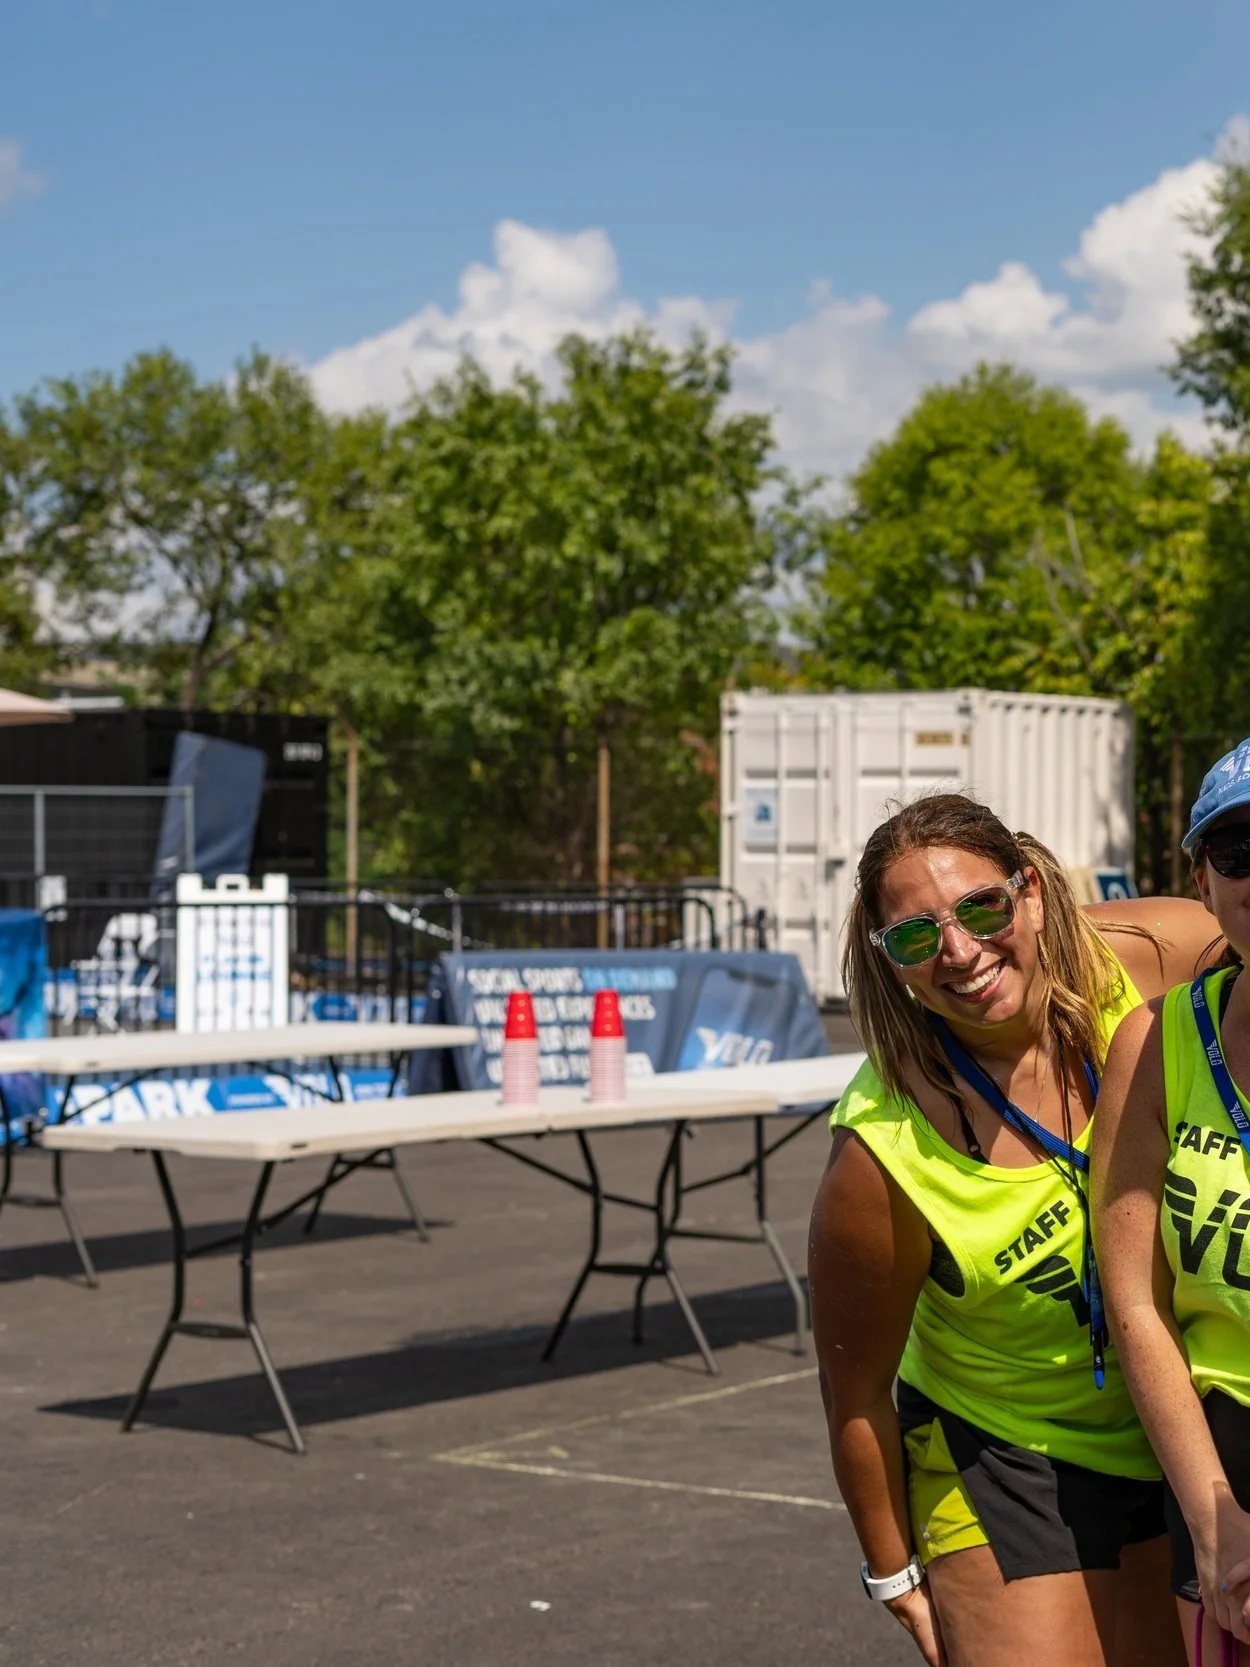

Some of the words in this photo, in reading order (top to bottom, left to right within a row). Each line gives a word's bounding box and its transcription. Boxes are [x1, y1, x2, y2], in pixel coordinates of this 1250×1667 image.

[1206, 1039, 1223, 1067] VOLO
[1229, 1101, 1249, 1129] VOLO
[994, 1200, 1070, 1275] STAFF
